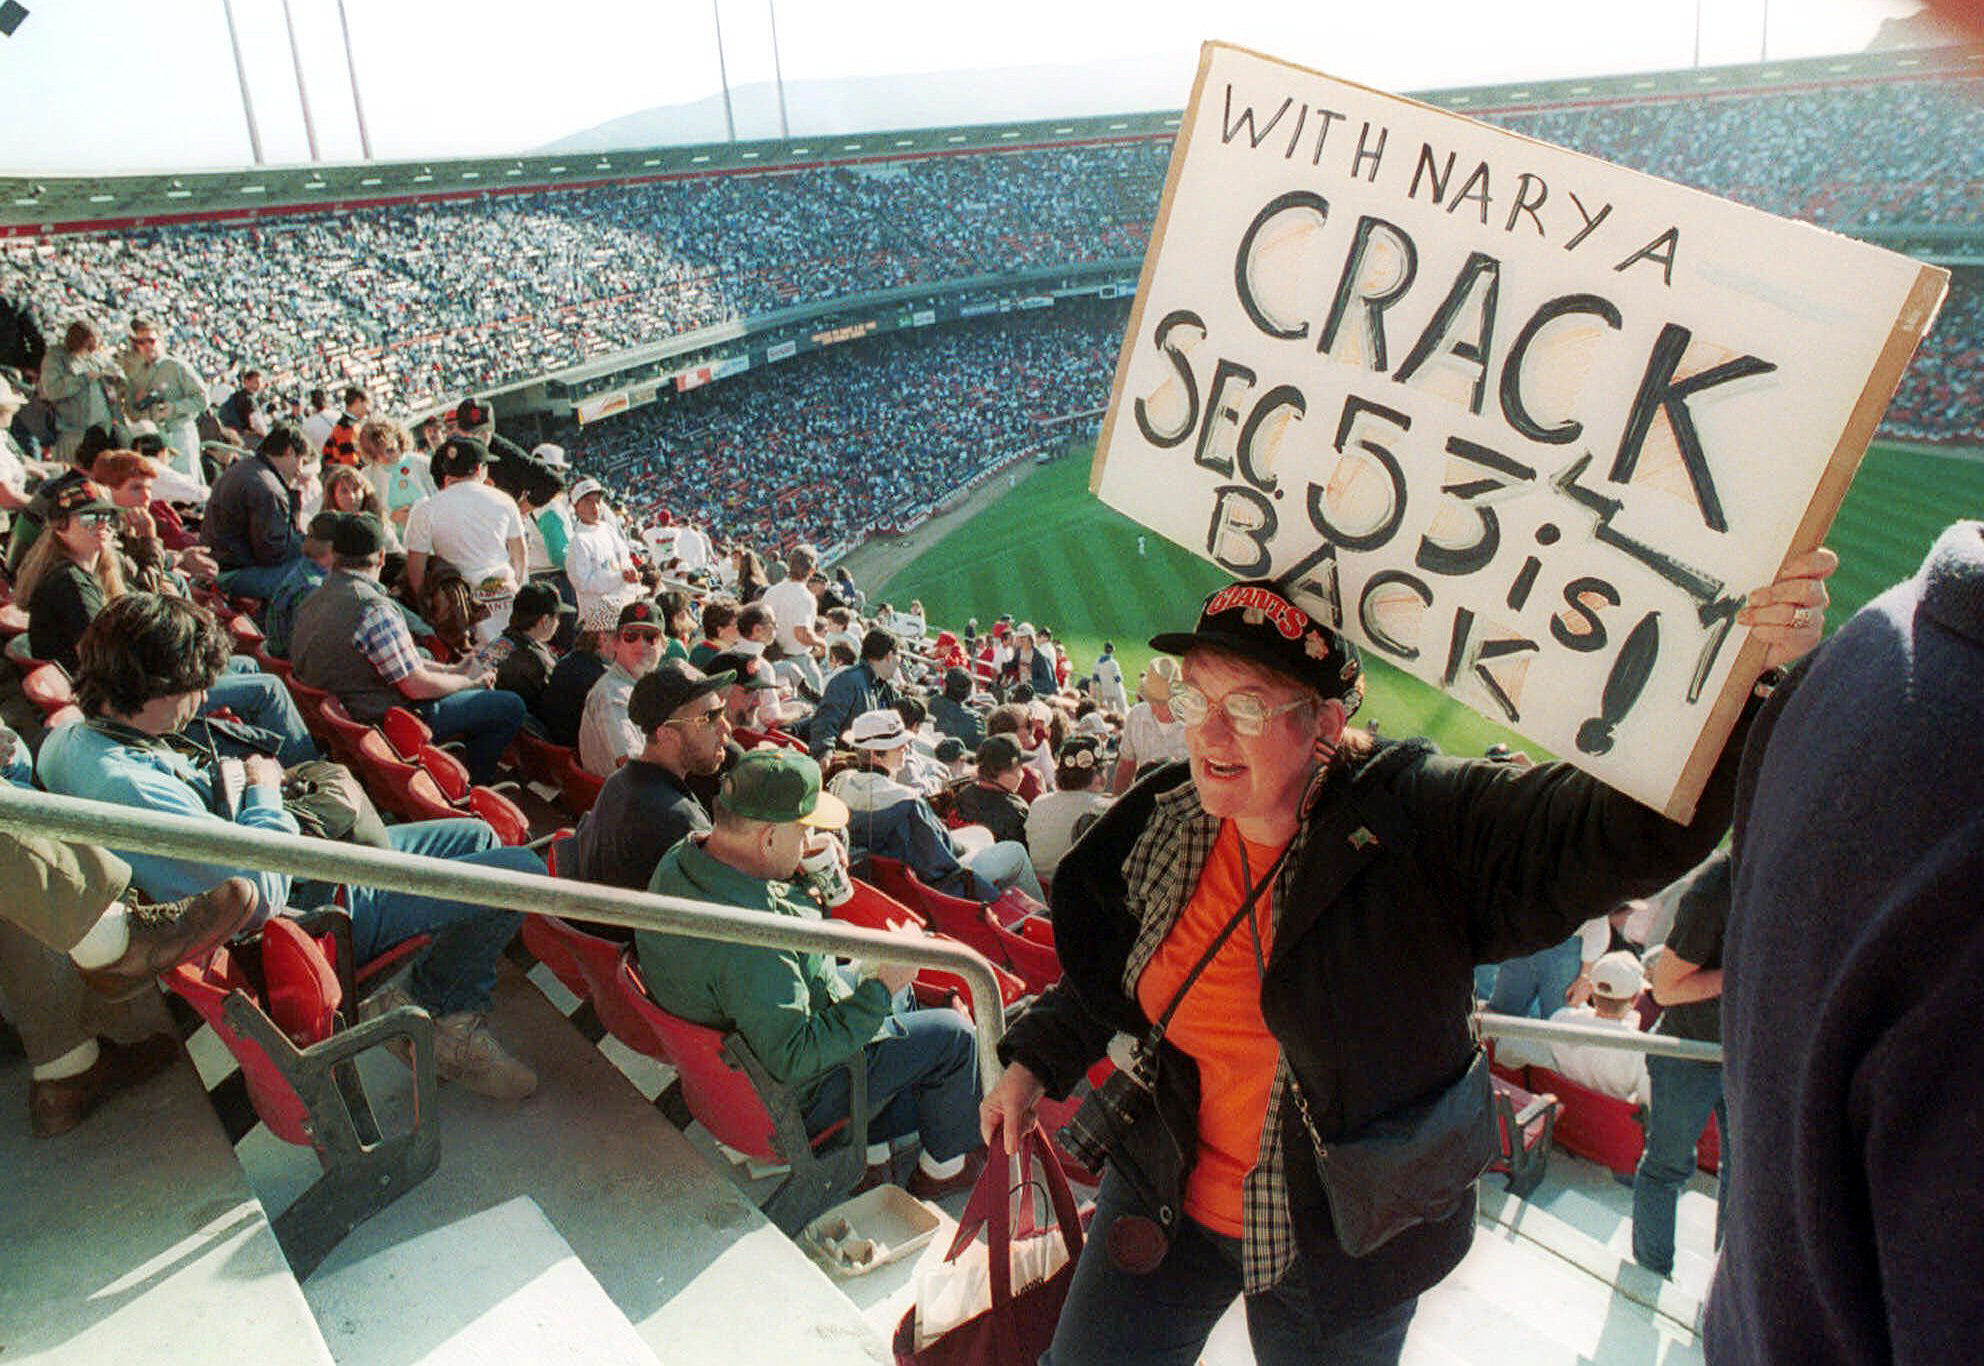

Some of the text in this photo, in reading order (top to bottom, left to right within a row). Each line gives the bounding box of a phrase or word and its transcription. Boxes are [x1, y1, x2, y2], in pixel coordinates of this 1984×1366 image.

[1221, 83, 1680, 286] WITH NARY A
[1134, 310, 1306, 502] SEC.
[1306, 394, 1537, 577] 53
[1233, 190, 1778, 534] CRACK
[1206, 585, 1309, 641] GIANTS
